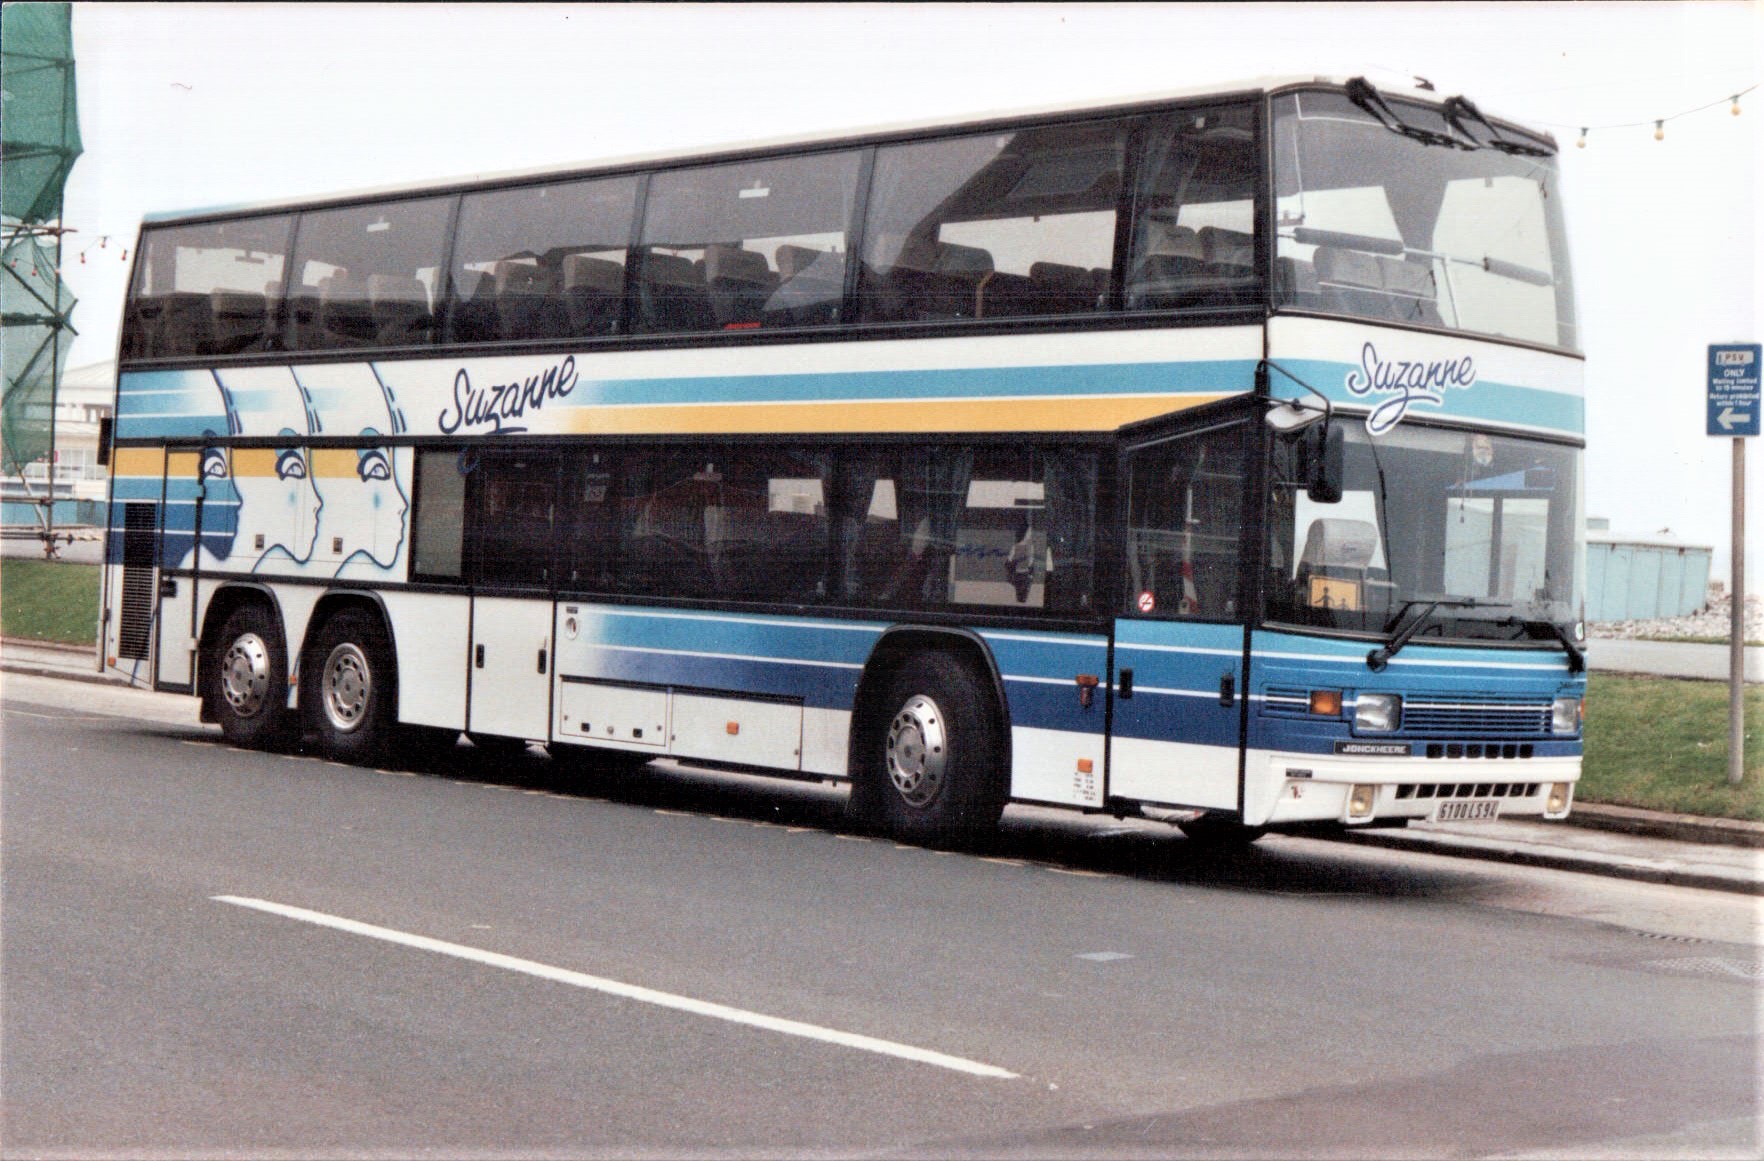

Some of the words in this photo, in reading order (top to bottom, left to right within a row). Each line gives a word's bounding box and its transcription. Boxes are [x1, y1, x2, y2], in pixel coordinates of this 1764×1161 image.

[438, 354, 580, 435] Suzanne
[1348, 341, 1477, 431] Suzanne
[1723, 368, 1745, 377] ONLY
[1342, 743, 1408, 754] JONCKHEERE
